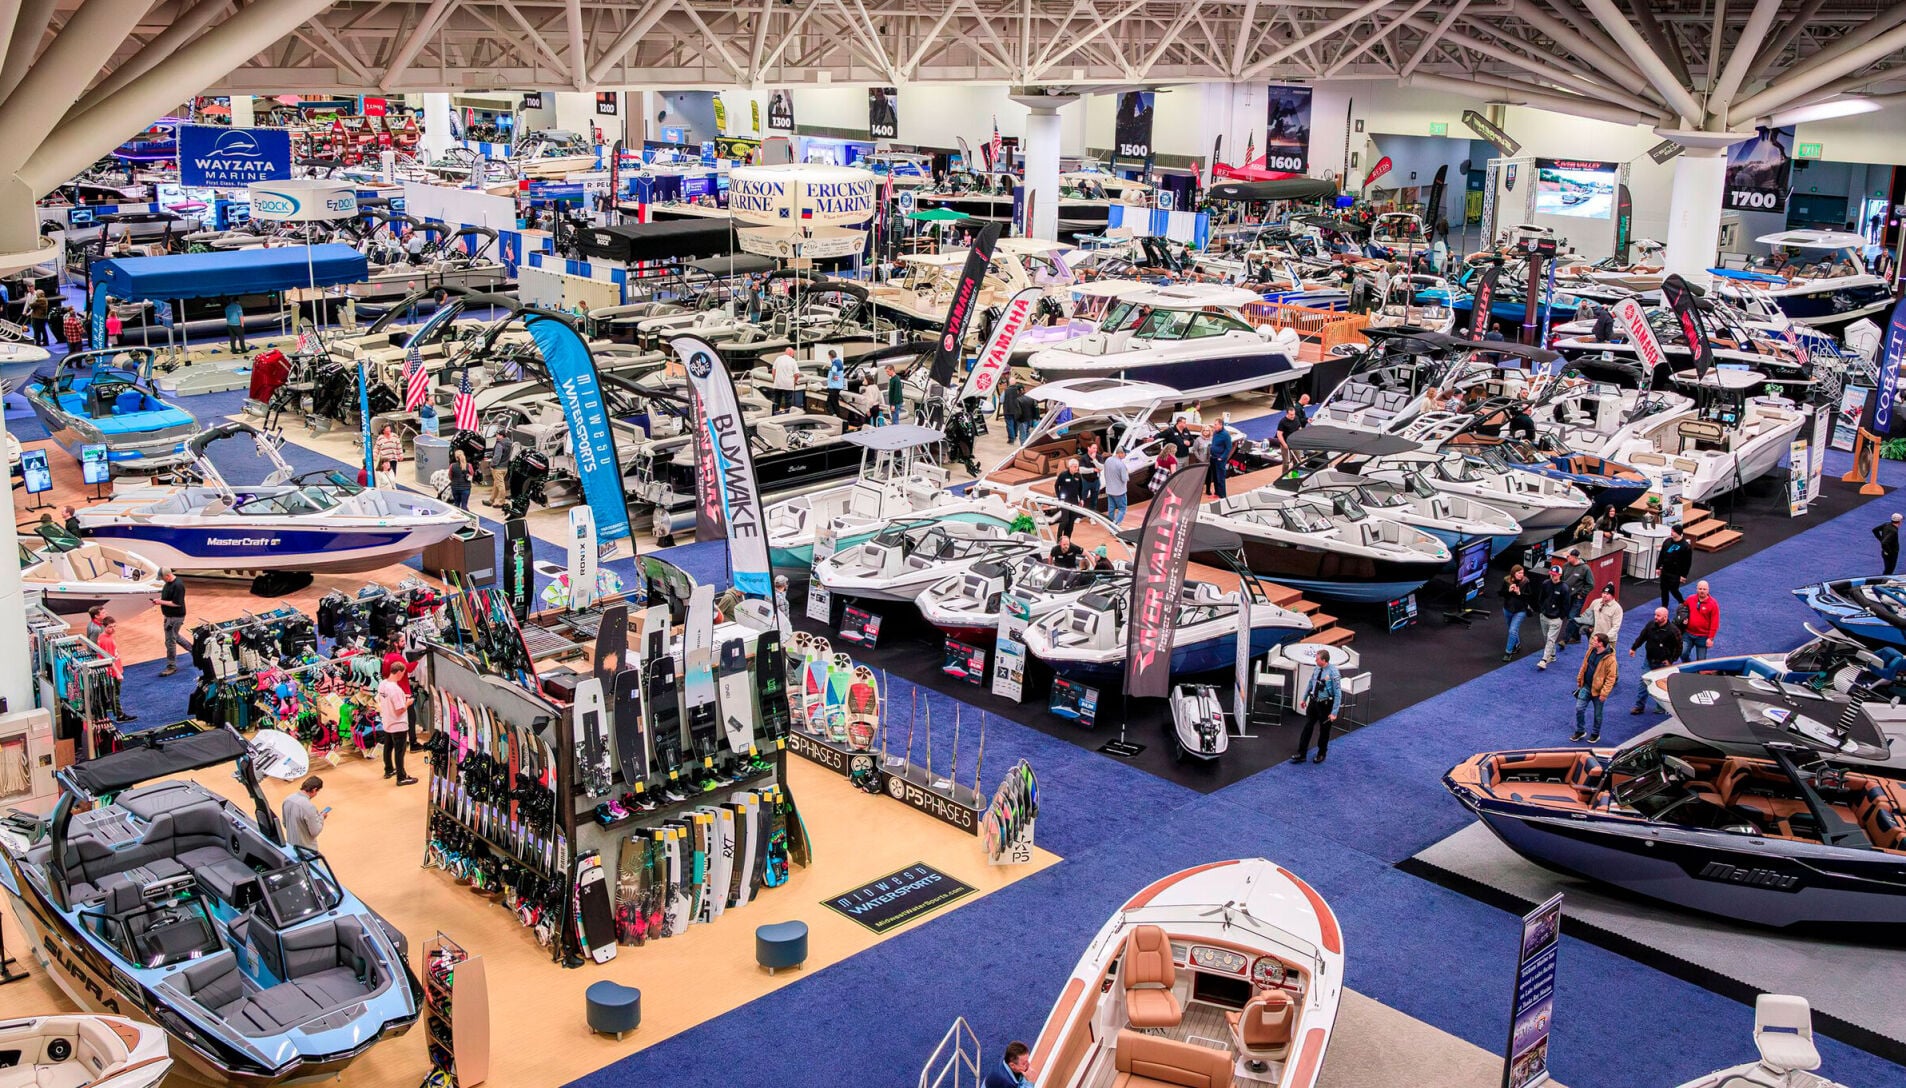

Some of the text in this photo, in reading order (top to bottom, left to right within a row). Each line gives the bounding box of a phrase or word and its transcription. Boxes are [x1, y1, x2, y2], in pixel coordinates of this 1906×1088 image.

[526, 97, 540, 108] 1100
[599, 103, 615, 113] 1200
[772, 116, 791, 128] 1300
[871, 124, 894, 136] 1400
[1120, 143, 1148, 157] 1500
[1799, 143, 1821, 157] EXIT
[195, 158, 275, 172] WAYZATA
[1270, 155, 1301, 170] 1600
[1373, 162, 1390, 178] REEDS
[205, 171, 268, 181] MARINE
[806, 179, 875, 198] ERICKSON
[815, 195, 872, 213] MARINE
[1731, 190, 1777, 209] 1700
[948, 276, 975, 335] YAMAHA
[1475, 282, 1491, 333] VALLEY
[983, 298, 1030, 370] YAMAHA
[1630, 314, 1659, 369] YAMAHA
[1876, 330, 1904, 426] COBALT
[562, 377, 598, 473] WATERSPORTS
[711, 412, 758, 540] BUYWAKE
[207, 537, 269, 546] MasterCraft
[1132, 487, 1182, 677] RIVER VALLEY
[1158, 616, 1171, 653] Power
[1166, 569, 1178, 604] Sport
[1173, 515, 1189, 560] Marine
[722, 834, 735, 859] RXT
[1012, 851, 1030, 863] P5
[848, 873, 942, 915] WATERSPORTS
[43, 934, 121, 1015] SUPRA
